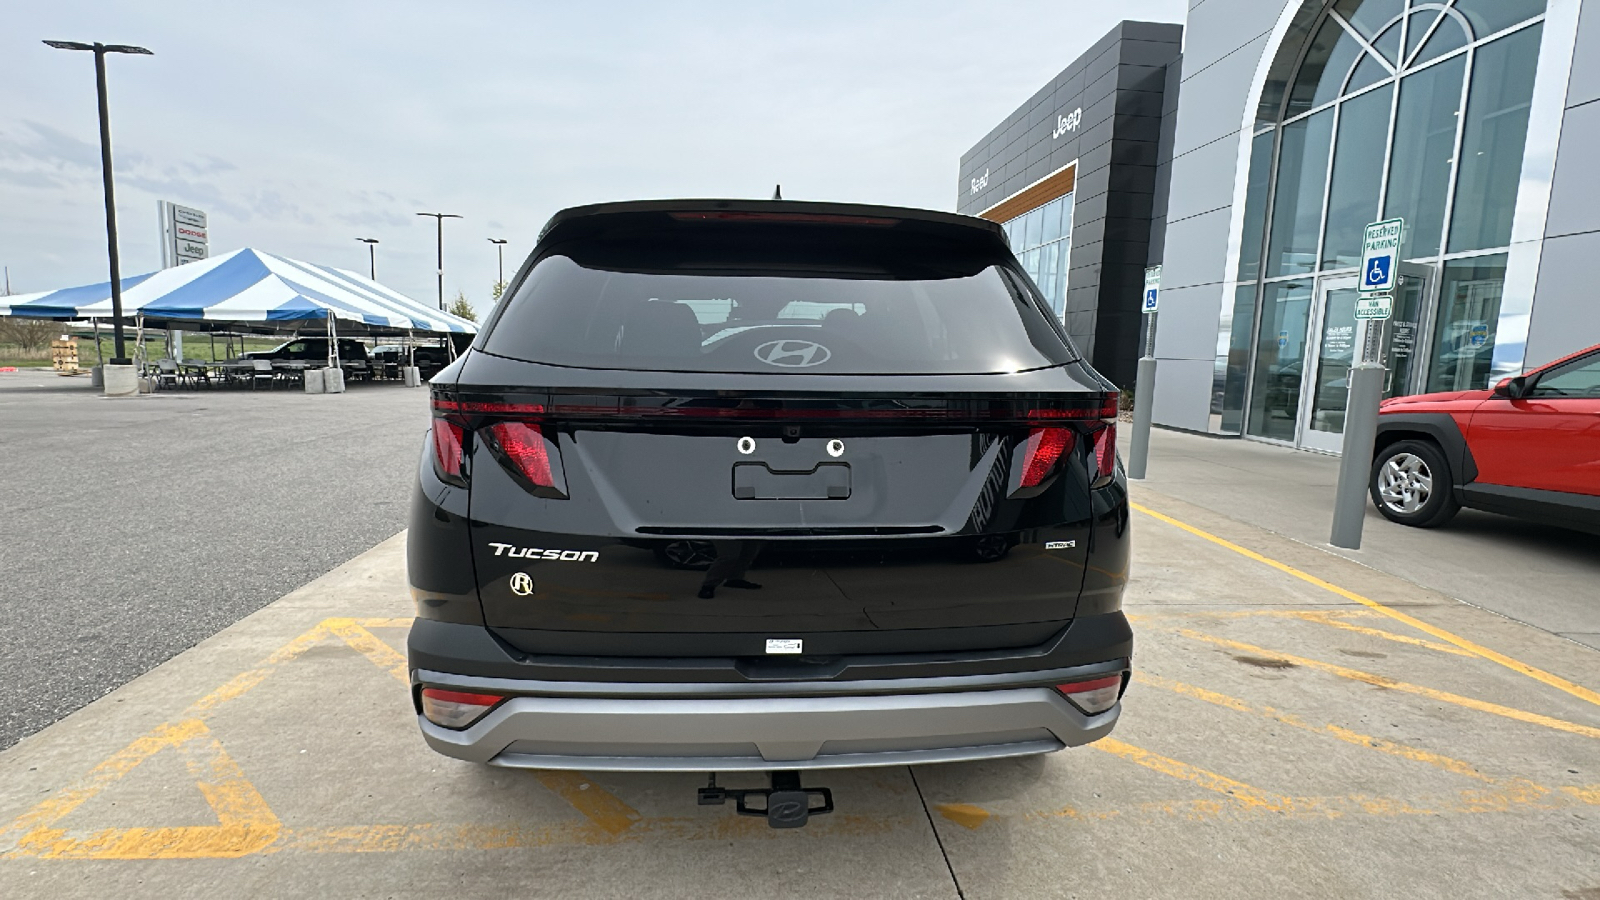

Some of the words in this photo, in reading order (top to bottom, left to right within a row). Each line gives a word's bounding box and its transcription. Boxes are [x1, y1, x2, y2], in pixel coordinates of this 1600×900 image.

[1053, 107, 1082, 139] Jeep
[970, 168, 989, 195] Reed
[178, 228, 206, 238] DODGE
[1368, 226, 1398, 239] RESERVED
[184, 243, 204, 256] Jeep
[1366, 238, 1397, 251] PARKING
[1357, 307, 1388, 315] ACCESSIBLE
